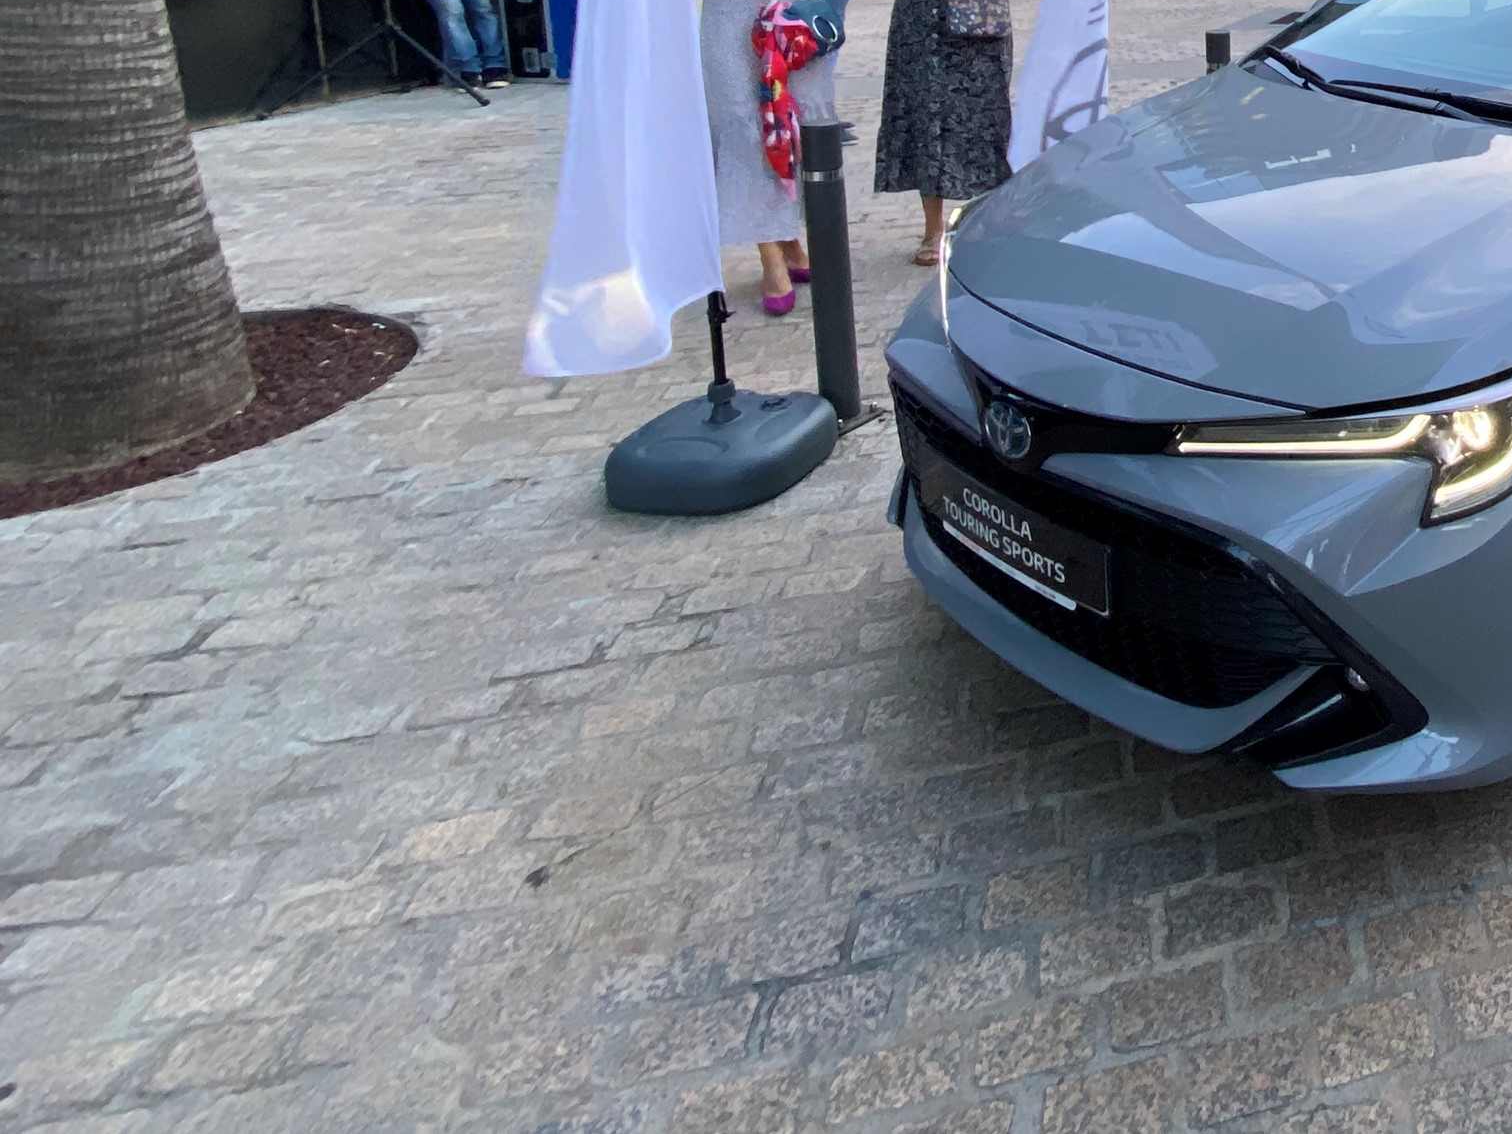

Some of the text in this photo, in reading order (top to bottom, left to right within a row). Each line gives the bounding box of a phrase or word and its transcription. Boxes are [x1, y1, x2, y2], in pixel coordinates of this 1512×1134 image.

[942, 495, 1066, 584] TOURING SPORTS
[962, 487, 1033, 542] COROLLA
